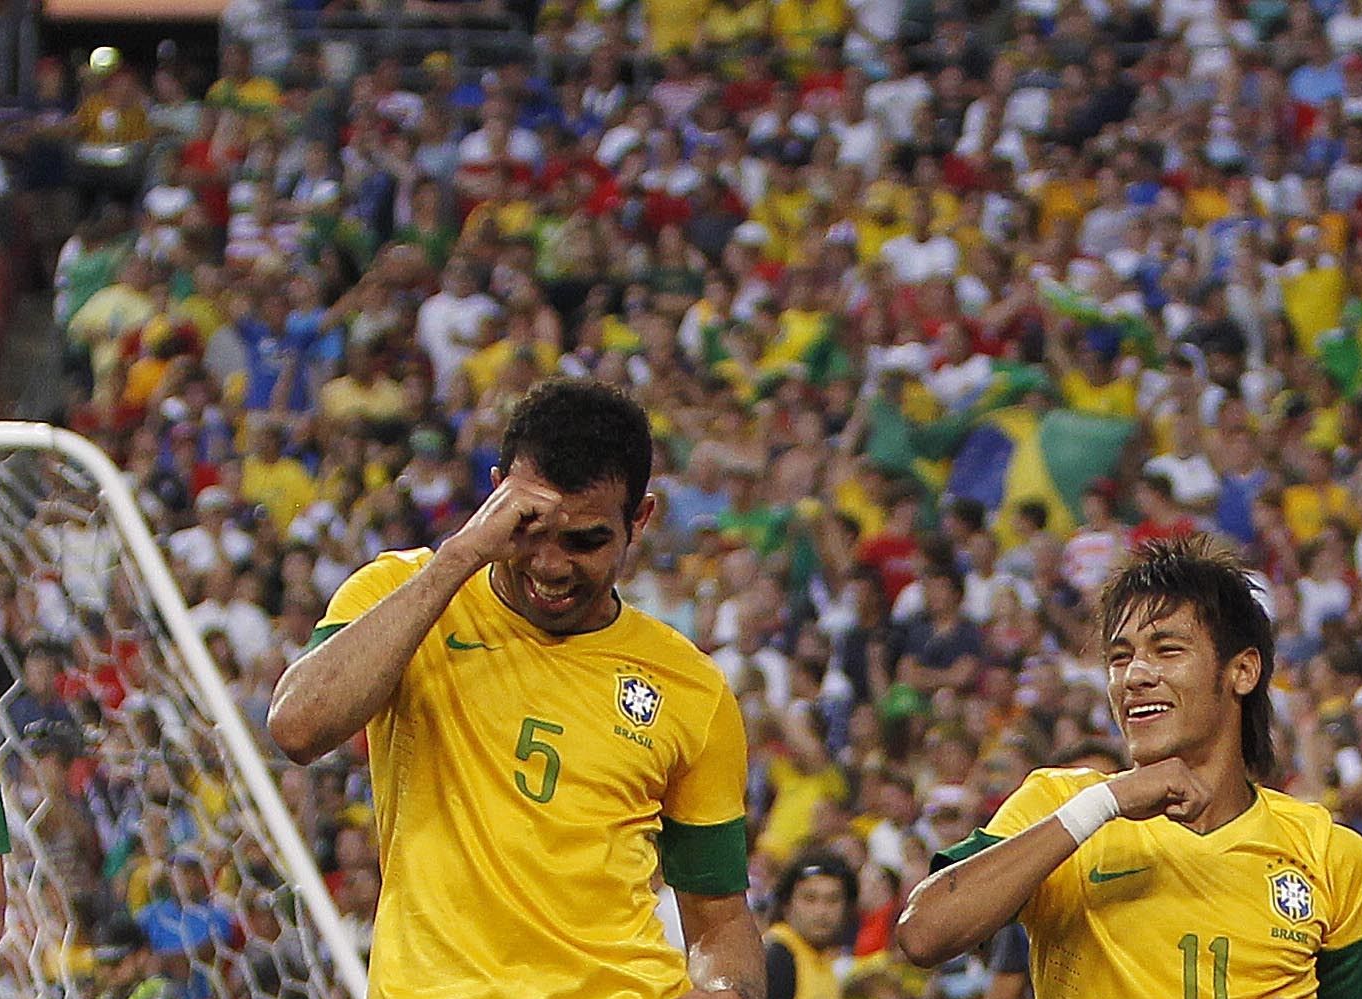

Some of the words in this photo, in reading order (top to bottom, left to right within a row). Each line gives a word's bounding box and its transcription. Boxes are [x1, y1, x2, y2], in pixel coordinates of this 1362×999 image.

[614, 725, 654, 750] BRASIL
[515, 717, 564, 804] 5
[1271, 927, 1309, 944] BRASIL
